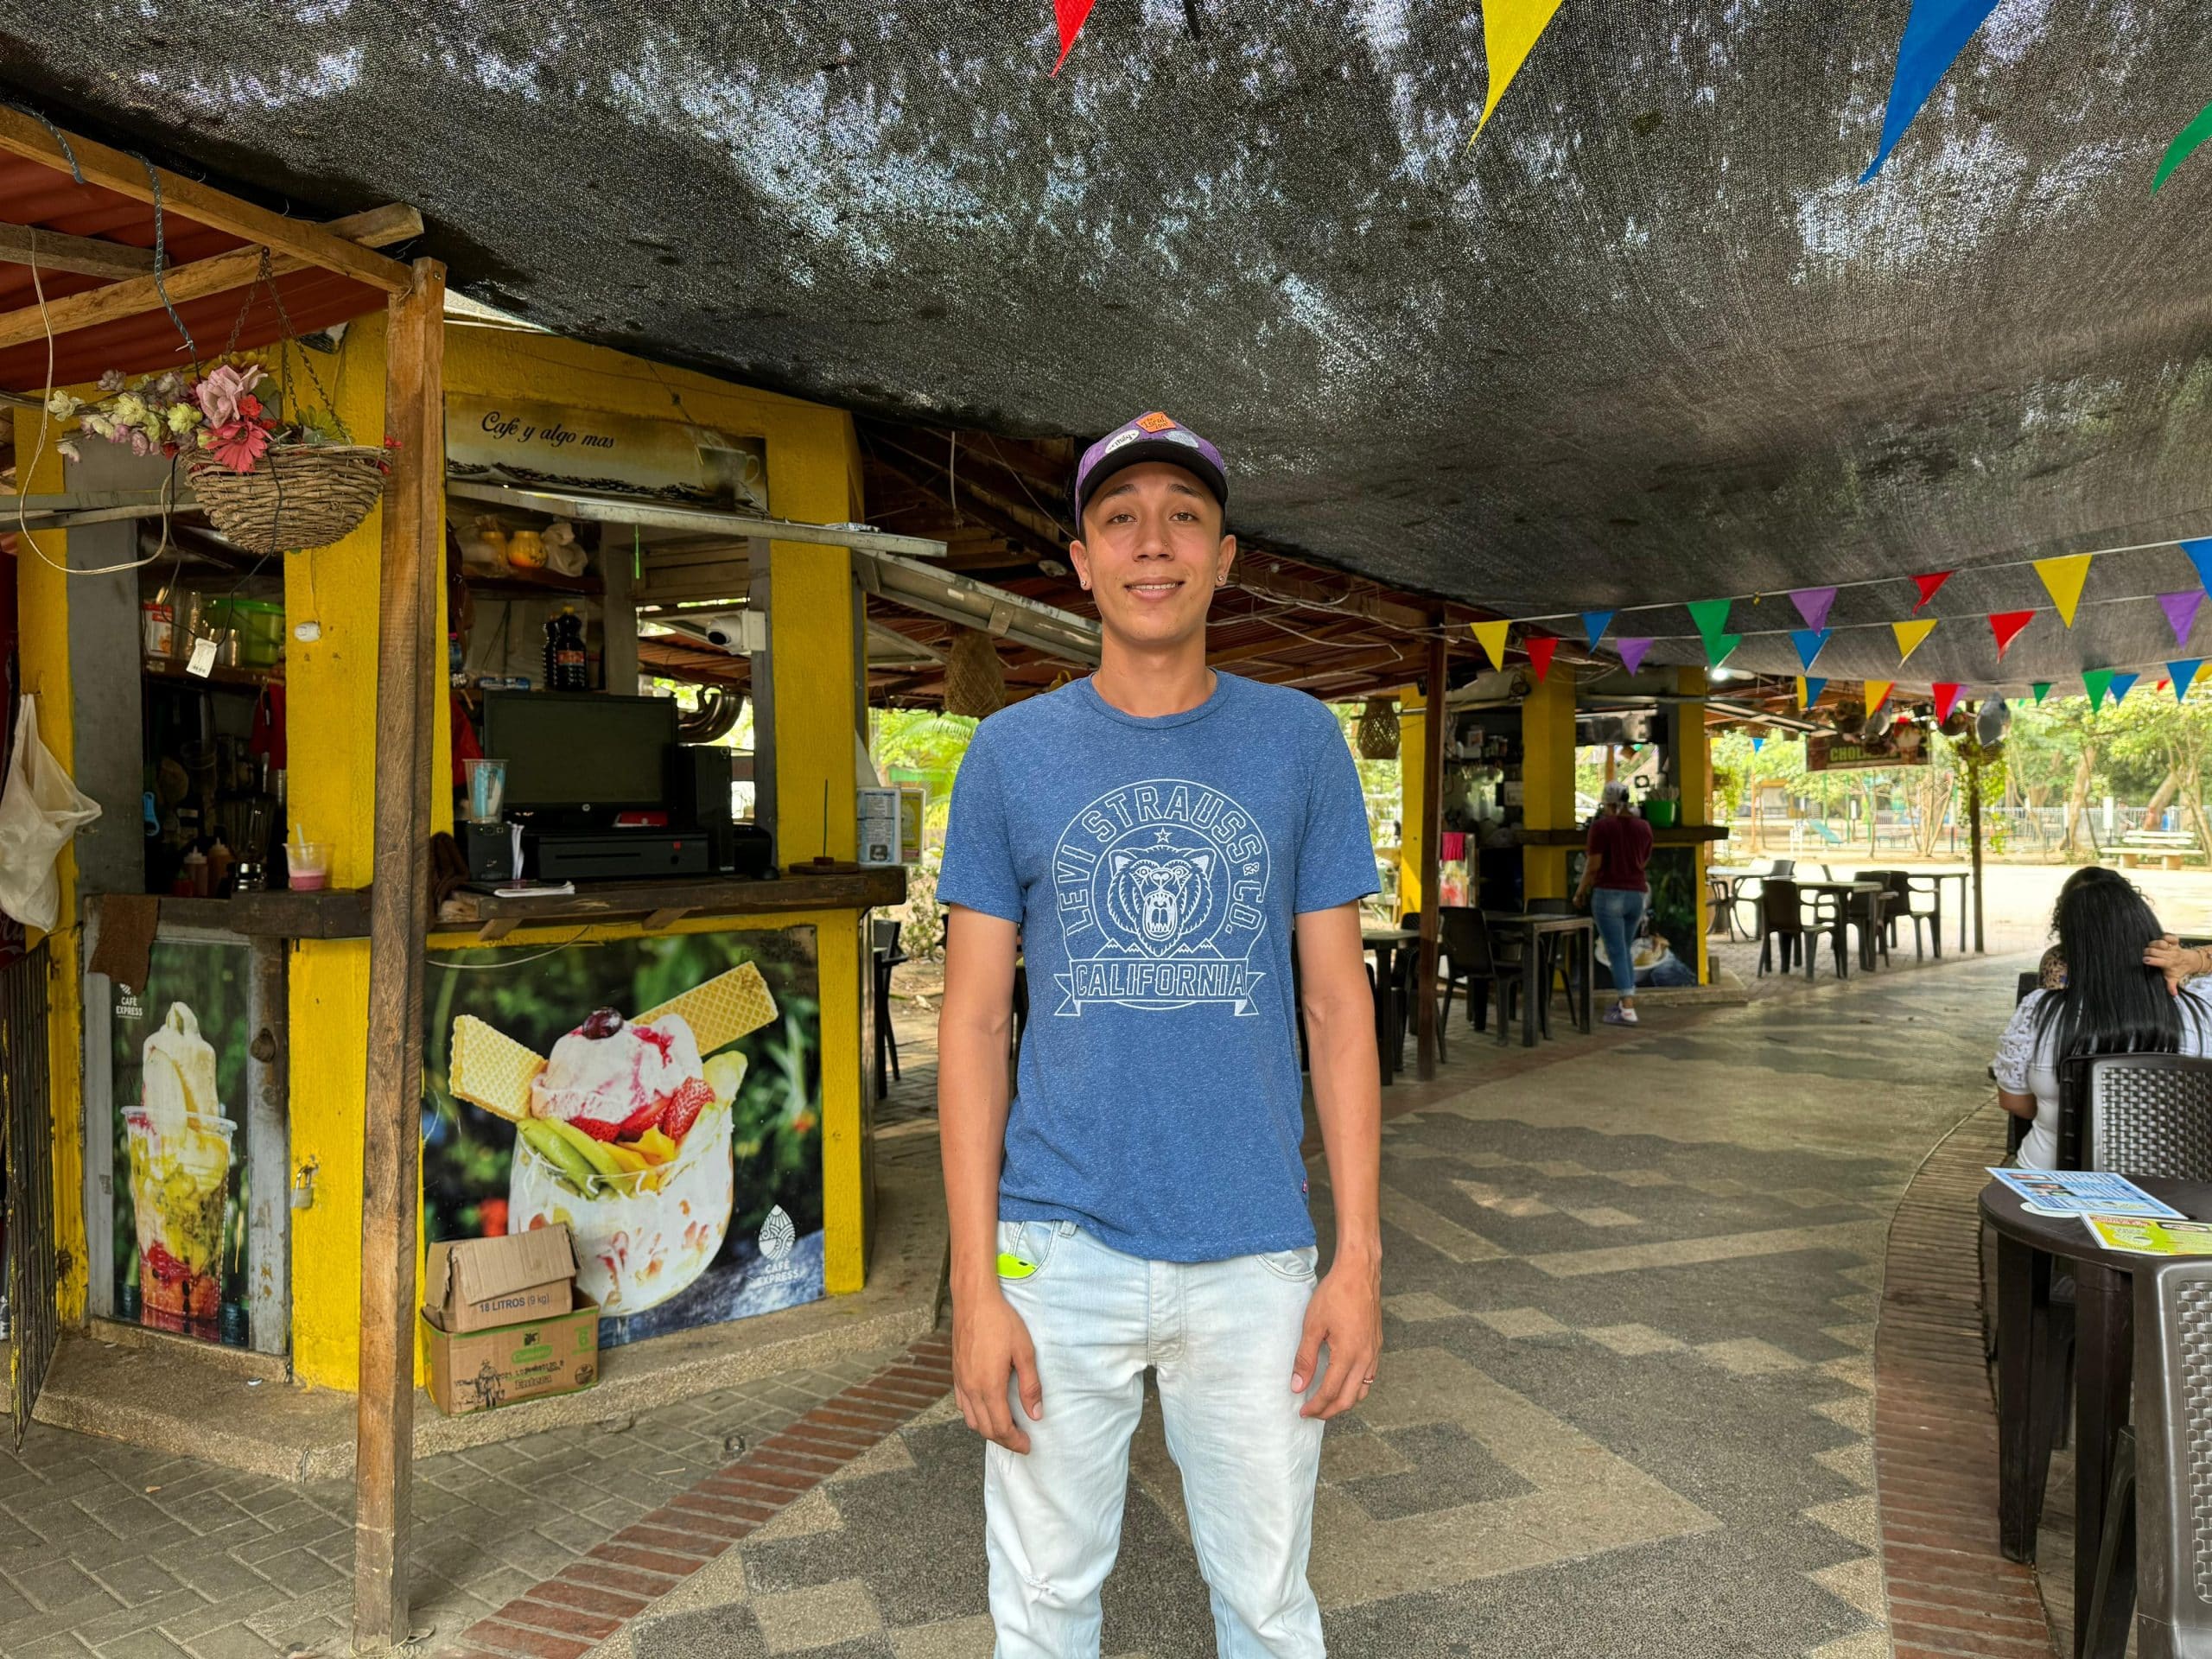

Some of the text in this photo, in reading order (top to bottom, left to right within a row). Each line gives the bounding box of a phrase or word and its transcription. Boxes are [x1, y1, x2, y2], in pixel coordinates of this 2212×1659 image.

[481, 410, 615, 448] Café y algo mas
[1057, 785, 1263, 937] LEVI STRAUSS & CO.
[1075, 963, 1247, 997] CALIFORNIA
[116, 1005, 143, 1016] EXPRESS
[480, 1293, 550, 1313] 18 LITROS (9 kg)
